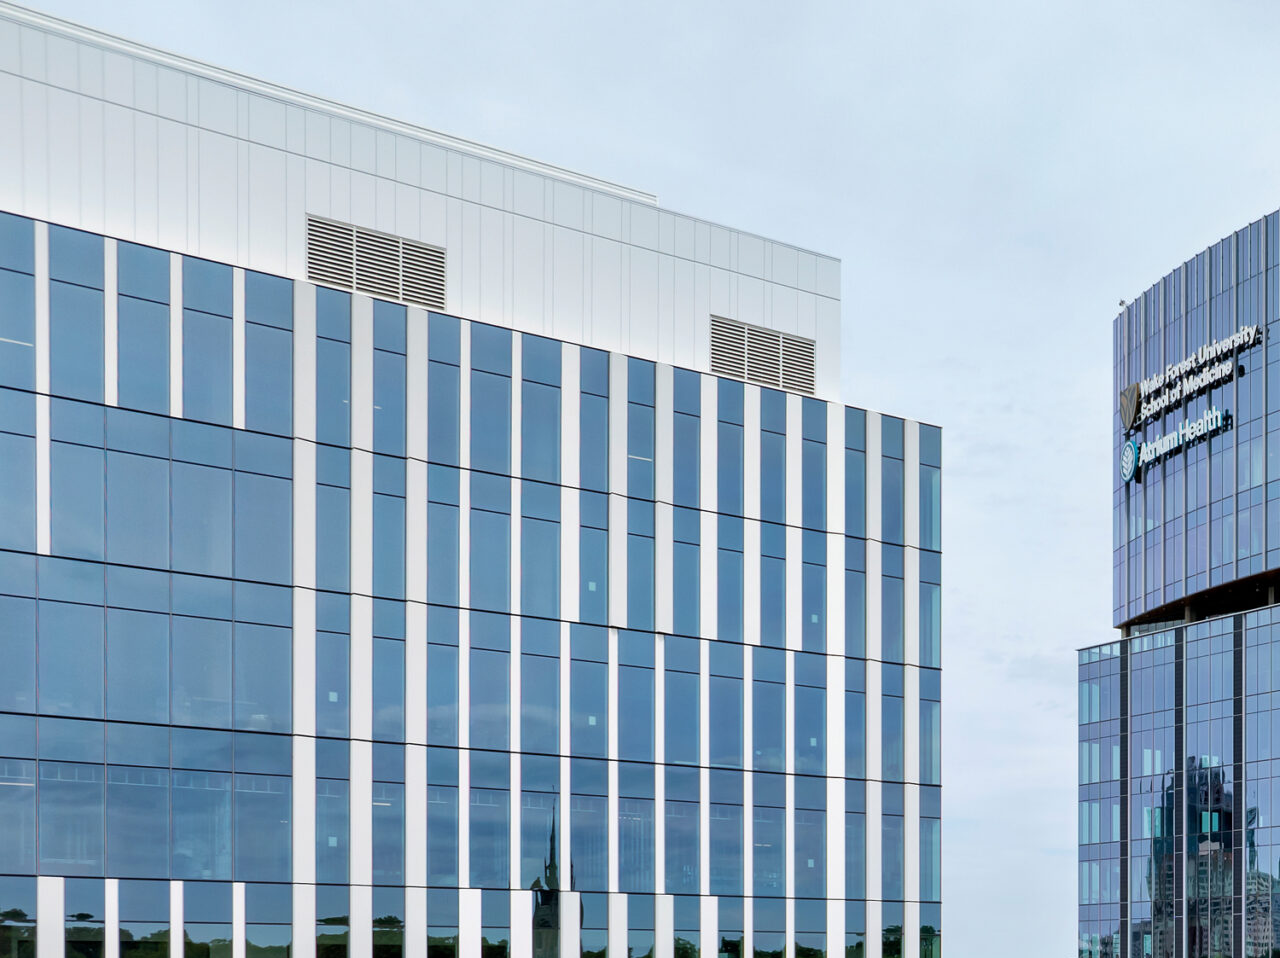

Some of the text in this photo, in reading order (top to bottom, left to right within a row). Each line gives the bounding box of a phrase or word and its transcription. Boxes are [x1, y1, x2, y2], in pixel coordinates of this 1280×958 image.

[1140, 324, 1258, 398] Wake Forest University
[1140, 360, 1233, 420] School of Medicine
[1138, 405, 1222, 467] Atrium Health
